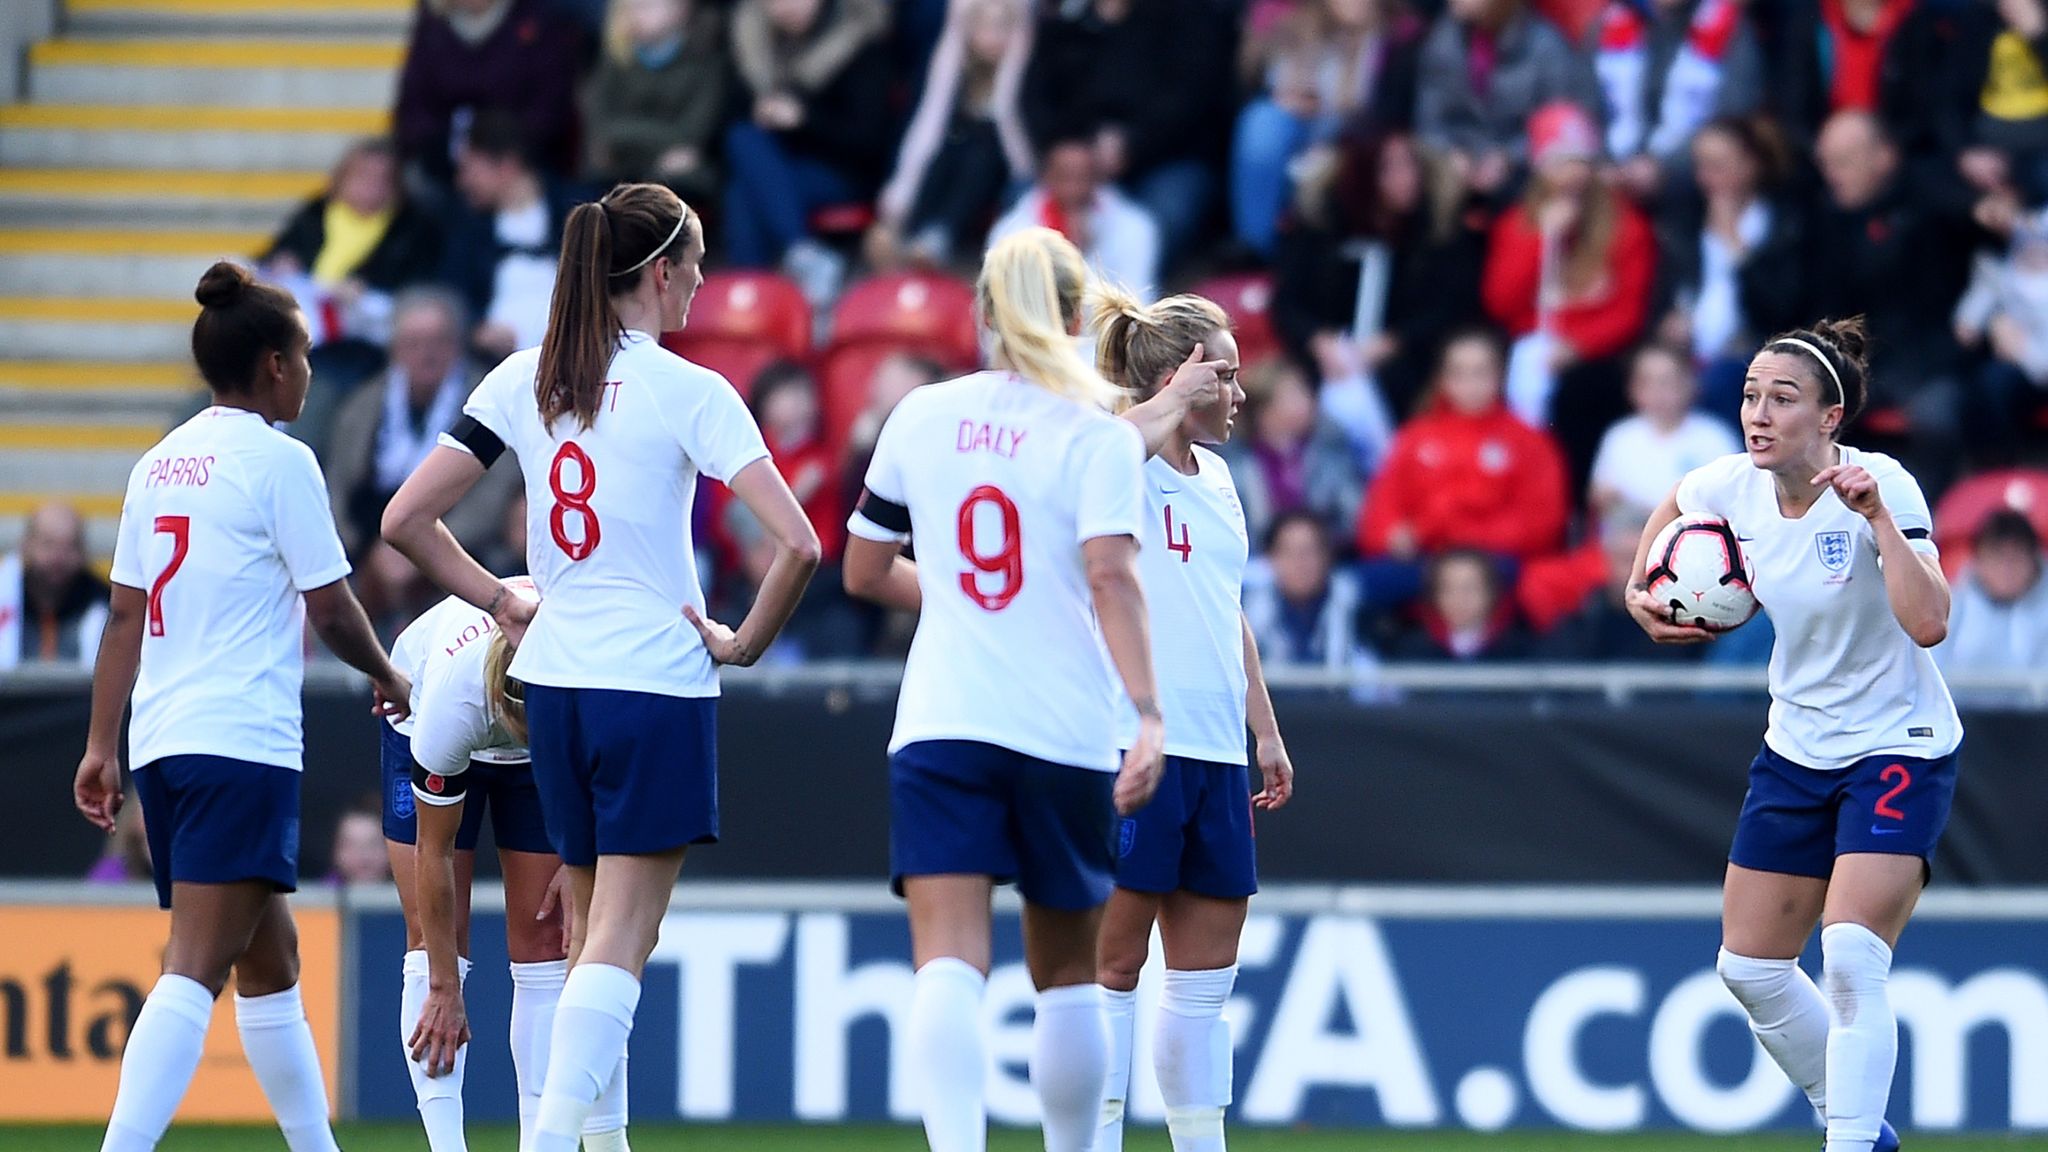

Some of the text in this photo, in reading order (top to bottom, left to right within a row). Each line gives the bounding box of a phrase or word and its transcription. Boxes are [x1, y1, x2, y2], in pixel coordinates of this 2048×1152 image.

[956, 420, 1026, 458] DALY
[145, 456, 216, 488] PARRIS
[549, 440, 601, 561] 8
[959, 485, 1022, 611] 9
[1164, 504, 1191, 563] 4
[150, 515, 190, 637] 7
[1874, 764, 1911, 820] 2
